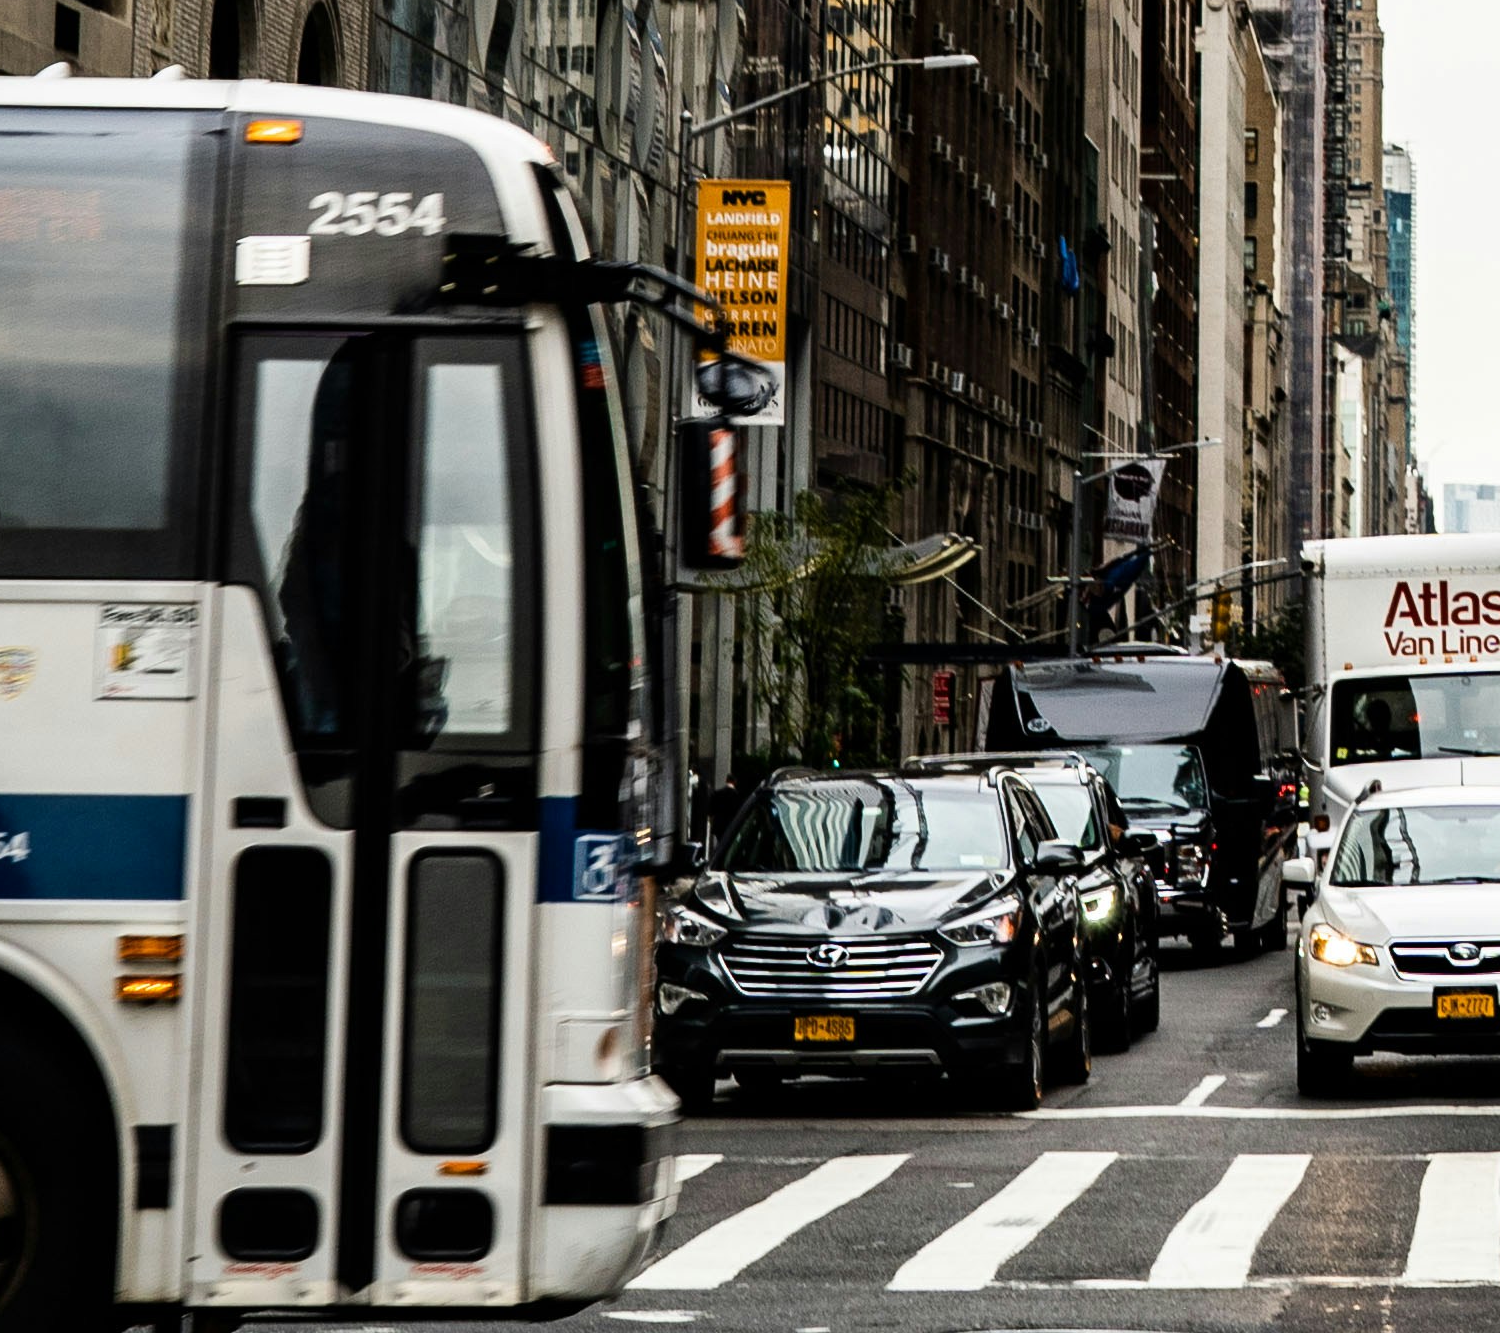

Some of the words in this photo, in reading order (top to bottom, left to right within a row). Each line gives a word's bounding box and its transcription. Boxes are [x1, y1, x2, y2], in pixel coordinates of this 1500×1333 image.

[722, 189, 766, 206] NYC
[306, 191, 448, 236] 2554
[706, 212, 781, 226] LANDFIELD
[706, 229, 755, 241] CHUANG
[705, 258, 779, 272] LACHAISE
[705, 271, 779, 290] HEINE
[1383, 631, 1434, 656] Van
